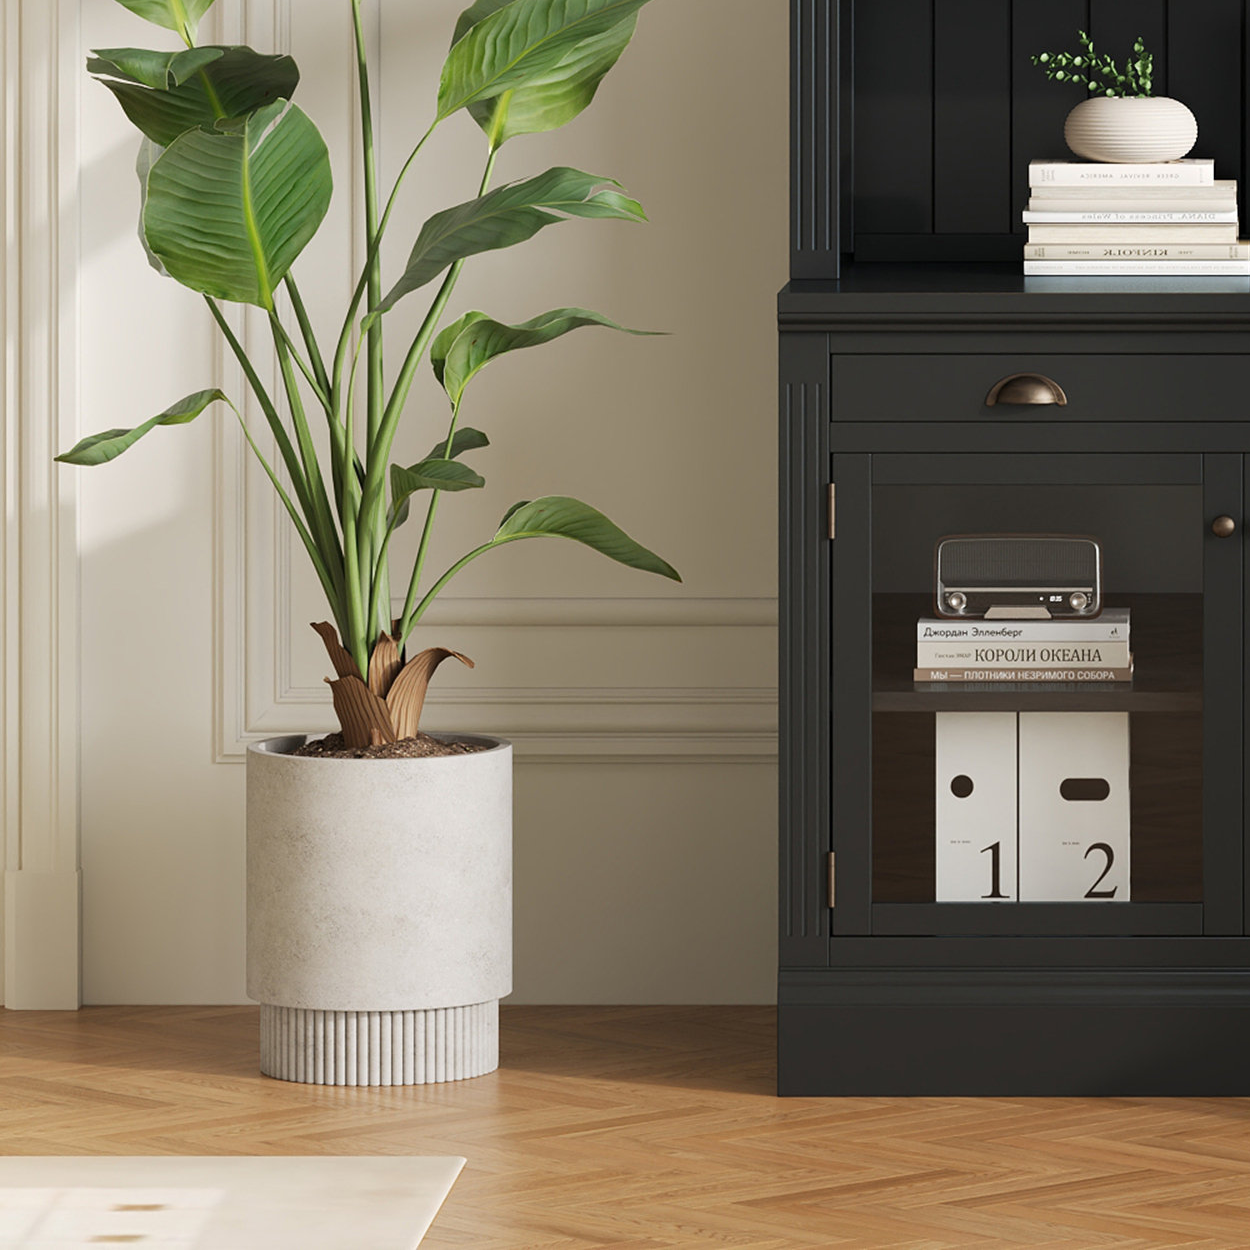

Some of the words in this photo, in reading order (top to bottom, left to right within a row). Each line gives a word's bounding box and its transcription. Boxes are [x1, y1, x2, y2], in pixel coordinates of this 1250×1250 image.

[923, 627, 968, 638] Джордан
[971, 627, 1022, 638] Элленберг
[975, 649, 1036, 662] КОРОЛИ
[1040, 649, 1102, 662] ОКЕАНА
[930, 671, 948, 680] МЫ
[964, 671, 1015, 680] ПЛОТНИКИ
[1017, 671, 1074, 680] НЕЗРИМОГО
[1077, 671, 1115, 680] СОБОРА
[980, 841, 1010, 898] 1
[1083, 842, 1118, 898] 2
